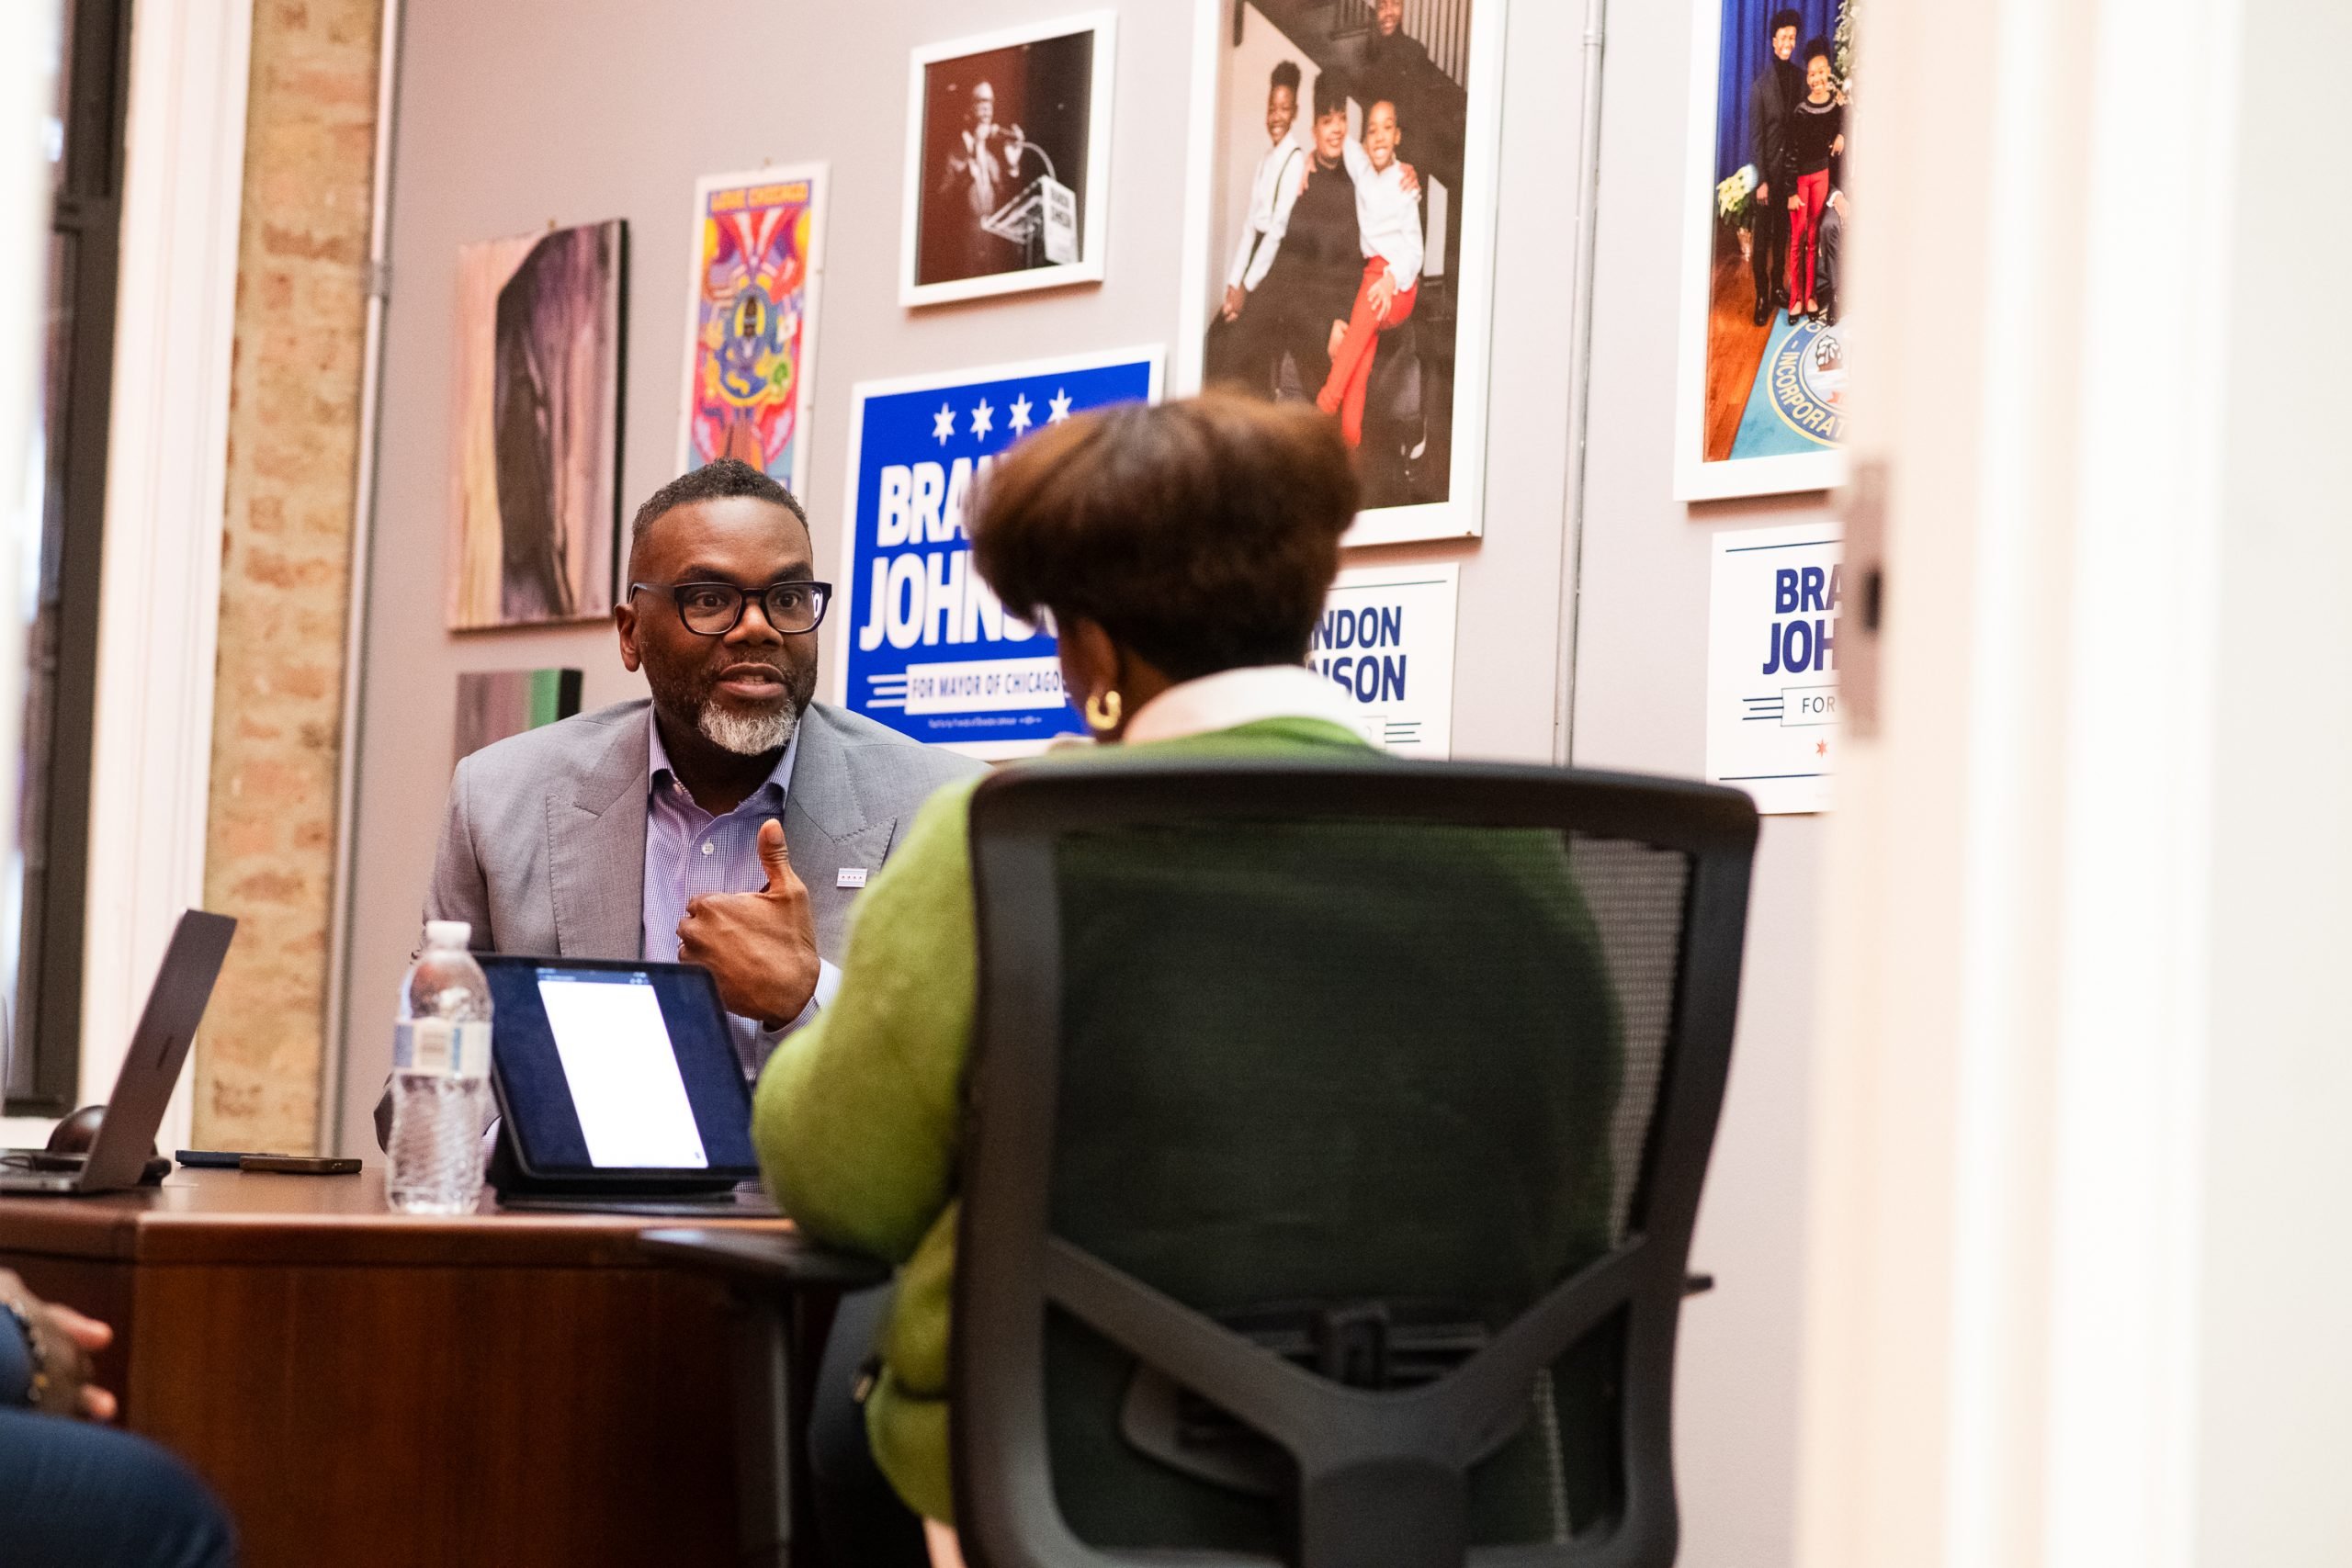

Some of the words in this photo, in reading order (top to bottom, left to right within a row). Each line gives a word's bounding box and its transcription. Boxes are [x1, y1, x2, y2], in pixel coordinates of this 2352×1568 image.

[859, 549, 1058, 651] JOHN
[1308, 605, 1402, 649] NDON
[913, 678, 933, 699] FOR
[940, 674, 980, 696] MAYOR
[985, 673, 1001, 695] OF
[1006, 671, 1059, 694] CHICAGO
[1802, 696, 1836, 714] FOR
